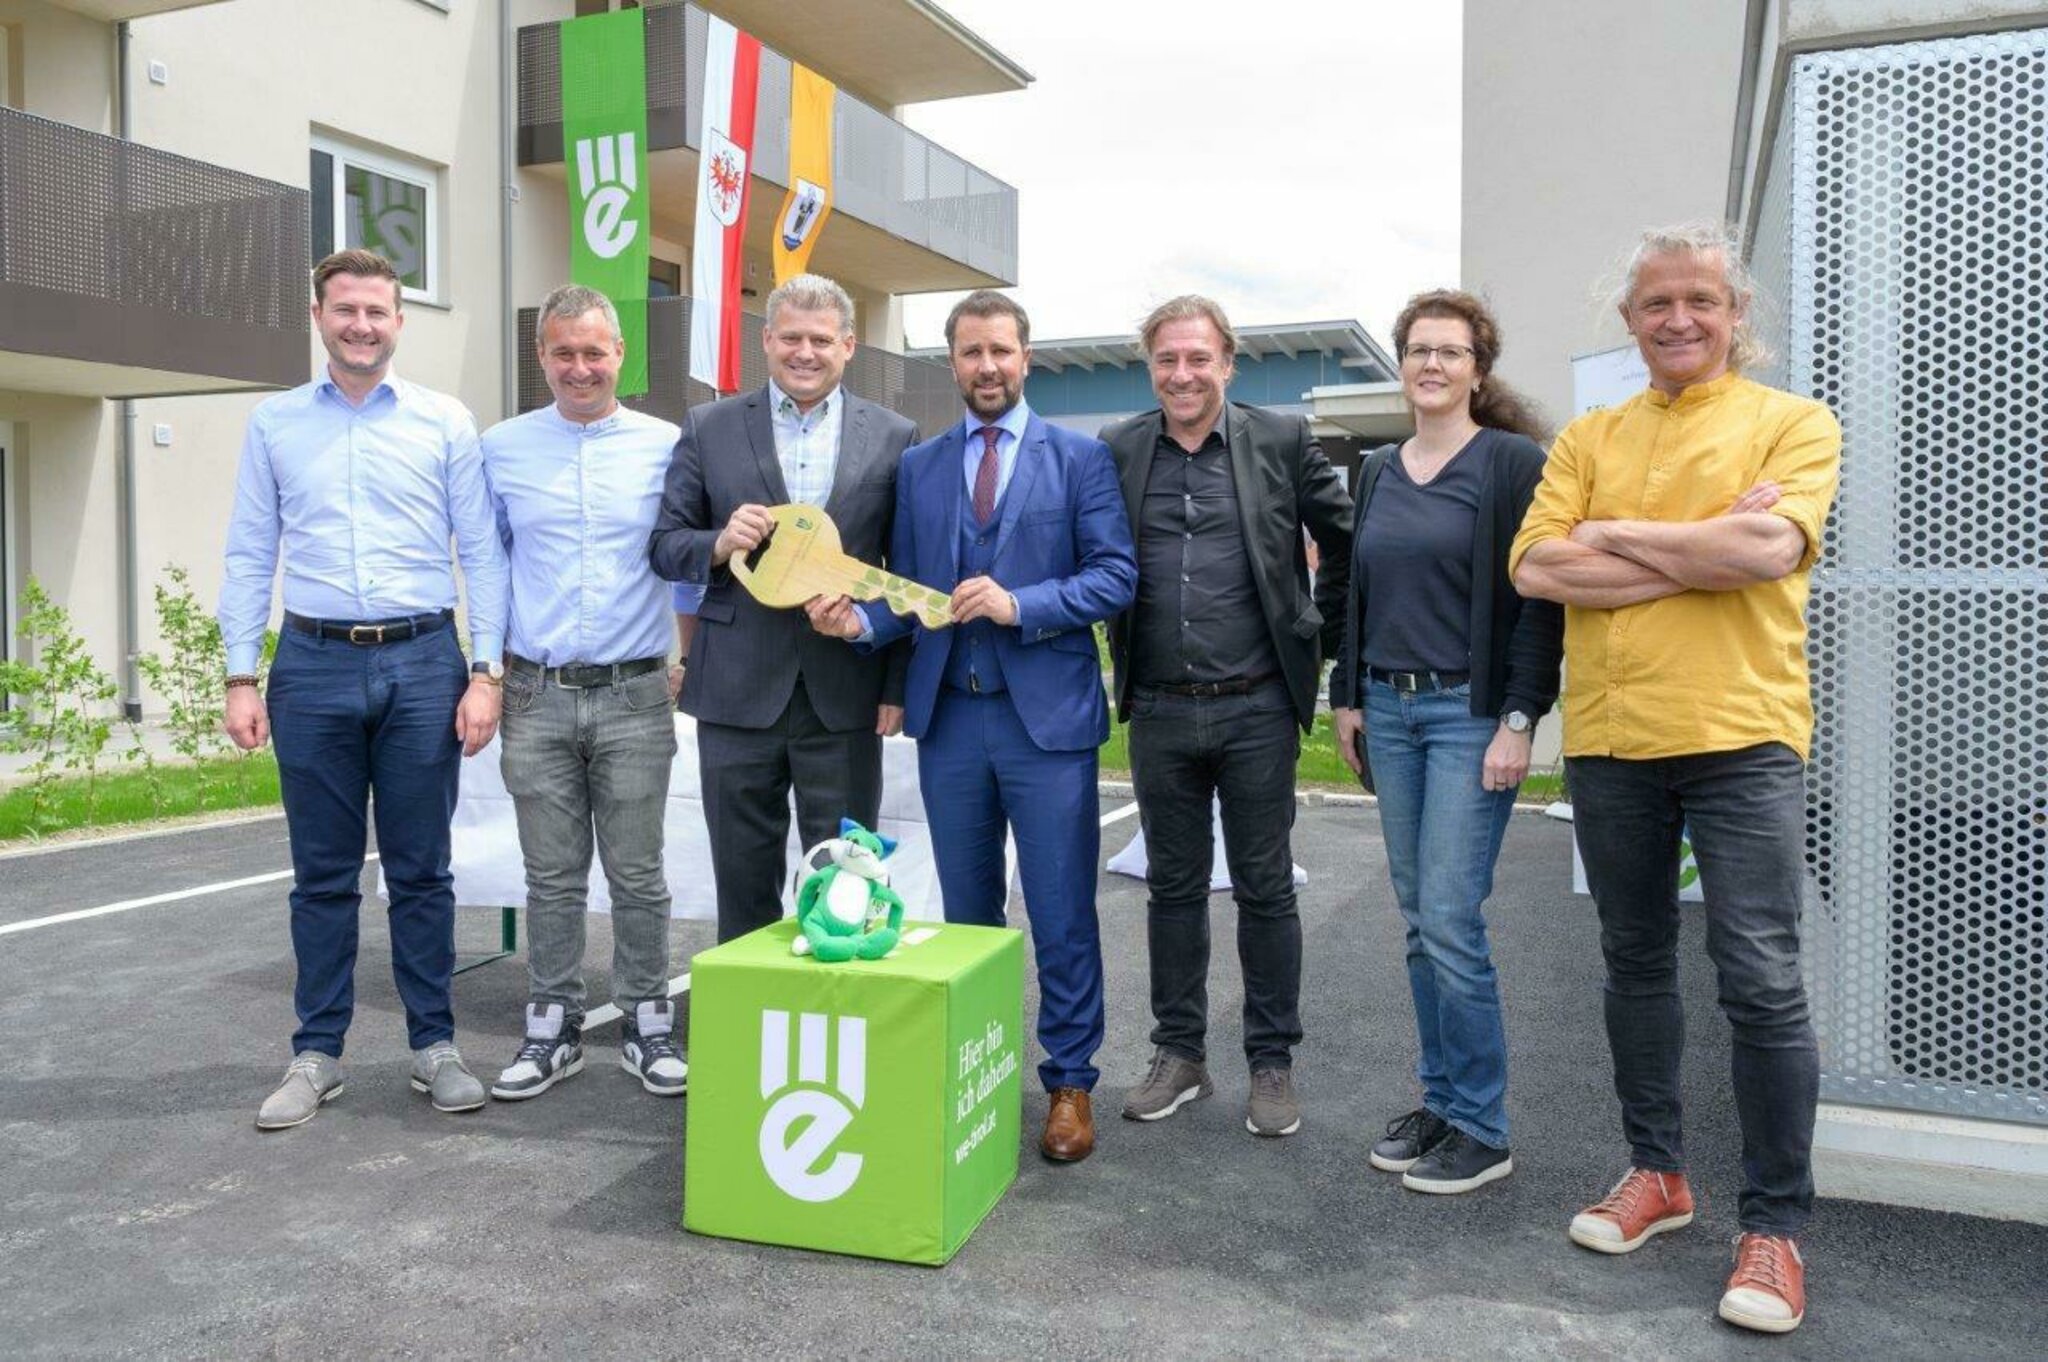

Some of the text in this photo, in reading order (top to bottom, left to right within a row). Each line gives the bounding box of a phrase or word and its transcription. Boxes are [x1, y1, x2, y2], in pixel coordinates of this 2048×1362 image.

[959, 1020, 1003, 1080] Hier bin
[956, 1078, 974, 1124] ich
